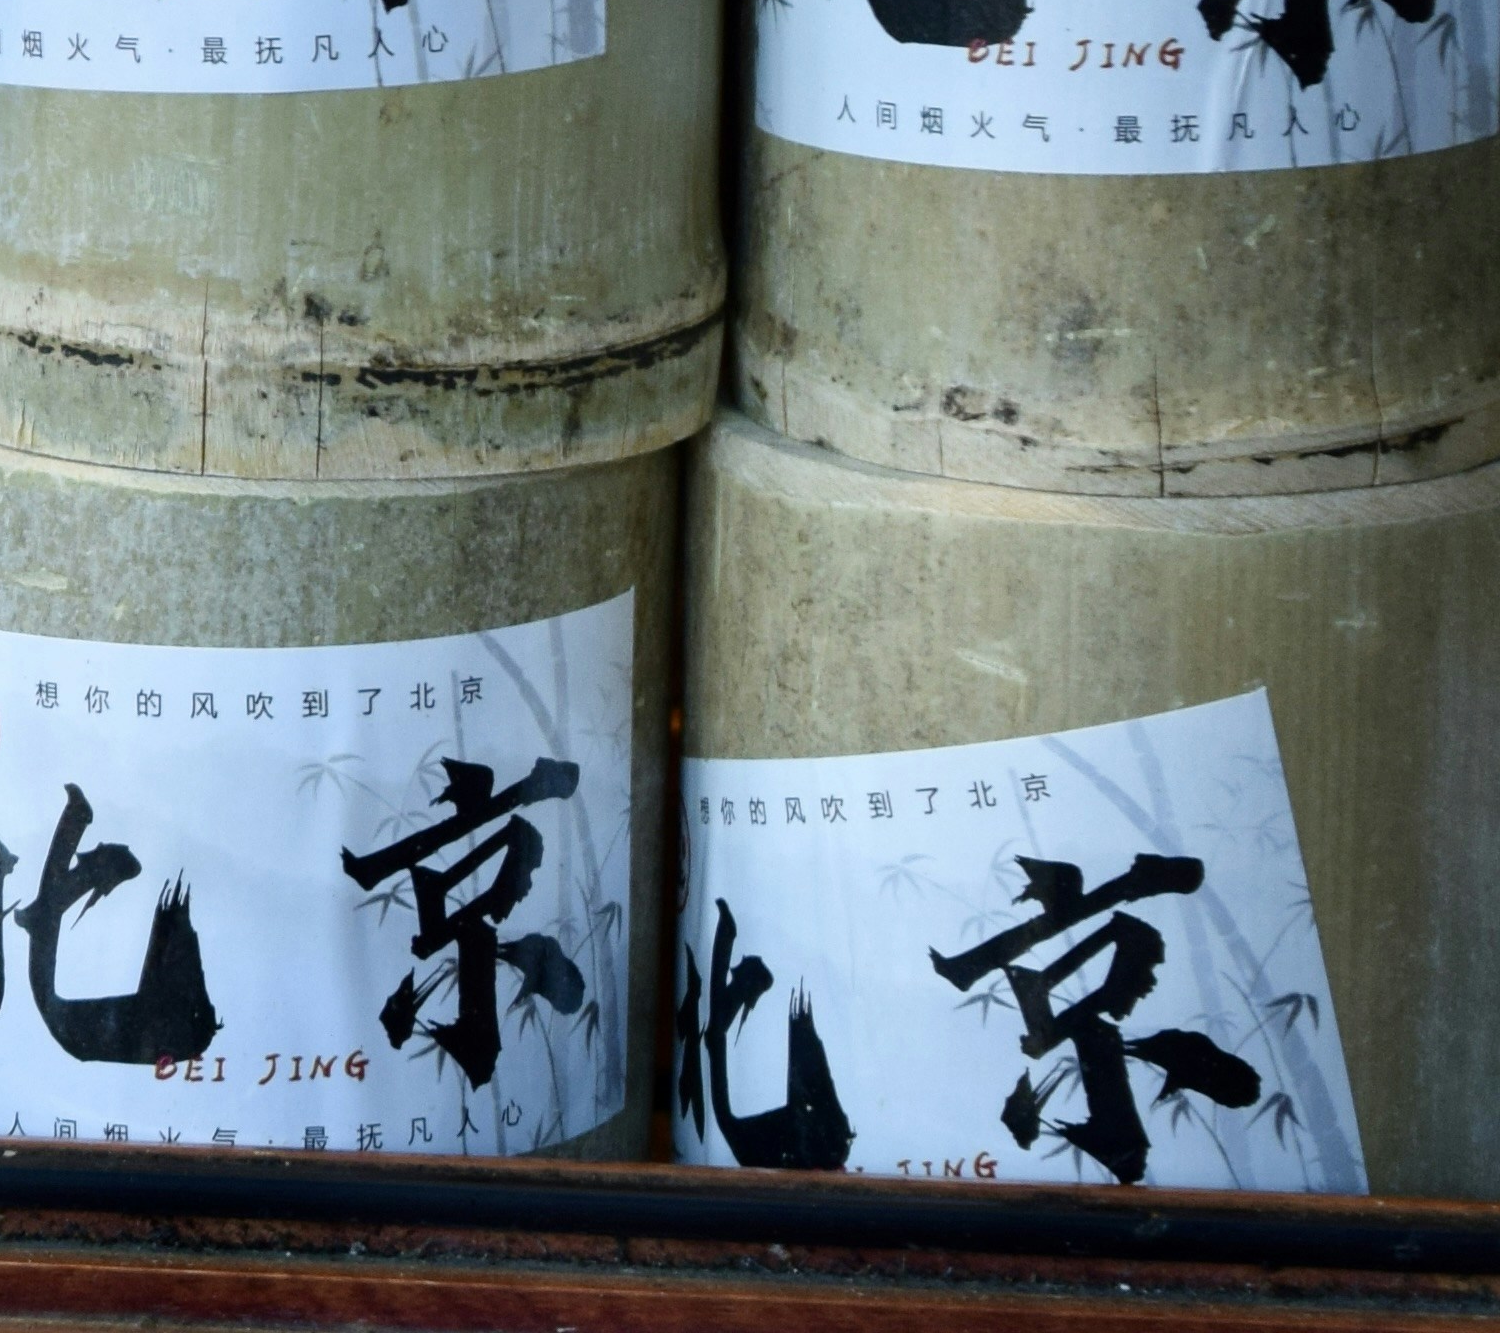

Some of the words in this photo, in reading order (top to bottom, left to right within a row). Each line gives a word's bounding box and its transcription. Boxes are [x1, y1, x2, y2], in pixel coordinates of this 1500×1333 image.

[967, 38, 1037, 68] BEI
[1068, 38, 1185, 70] JING
[35, 676, 484, 720] 想你的风吹到了北京
[676, 852, 1262, 1183] 北京
[155, 1057, 225, 1083] BEI
[258, 1050, 370, 1086] JING
